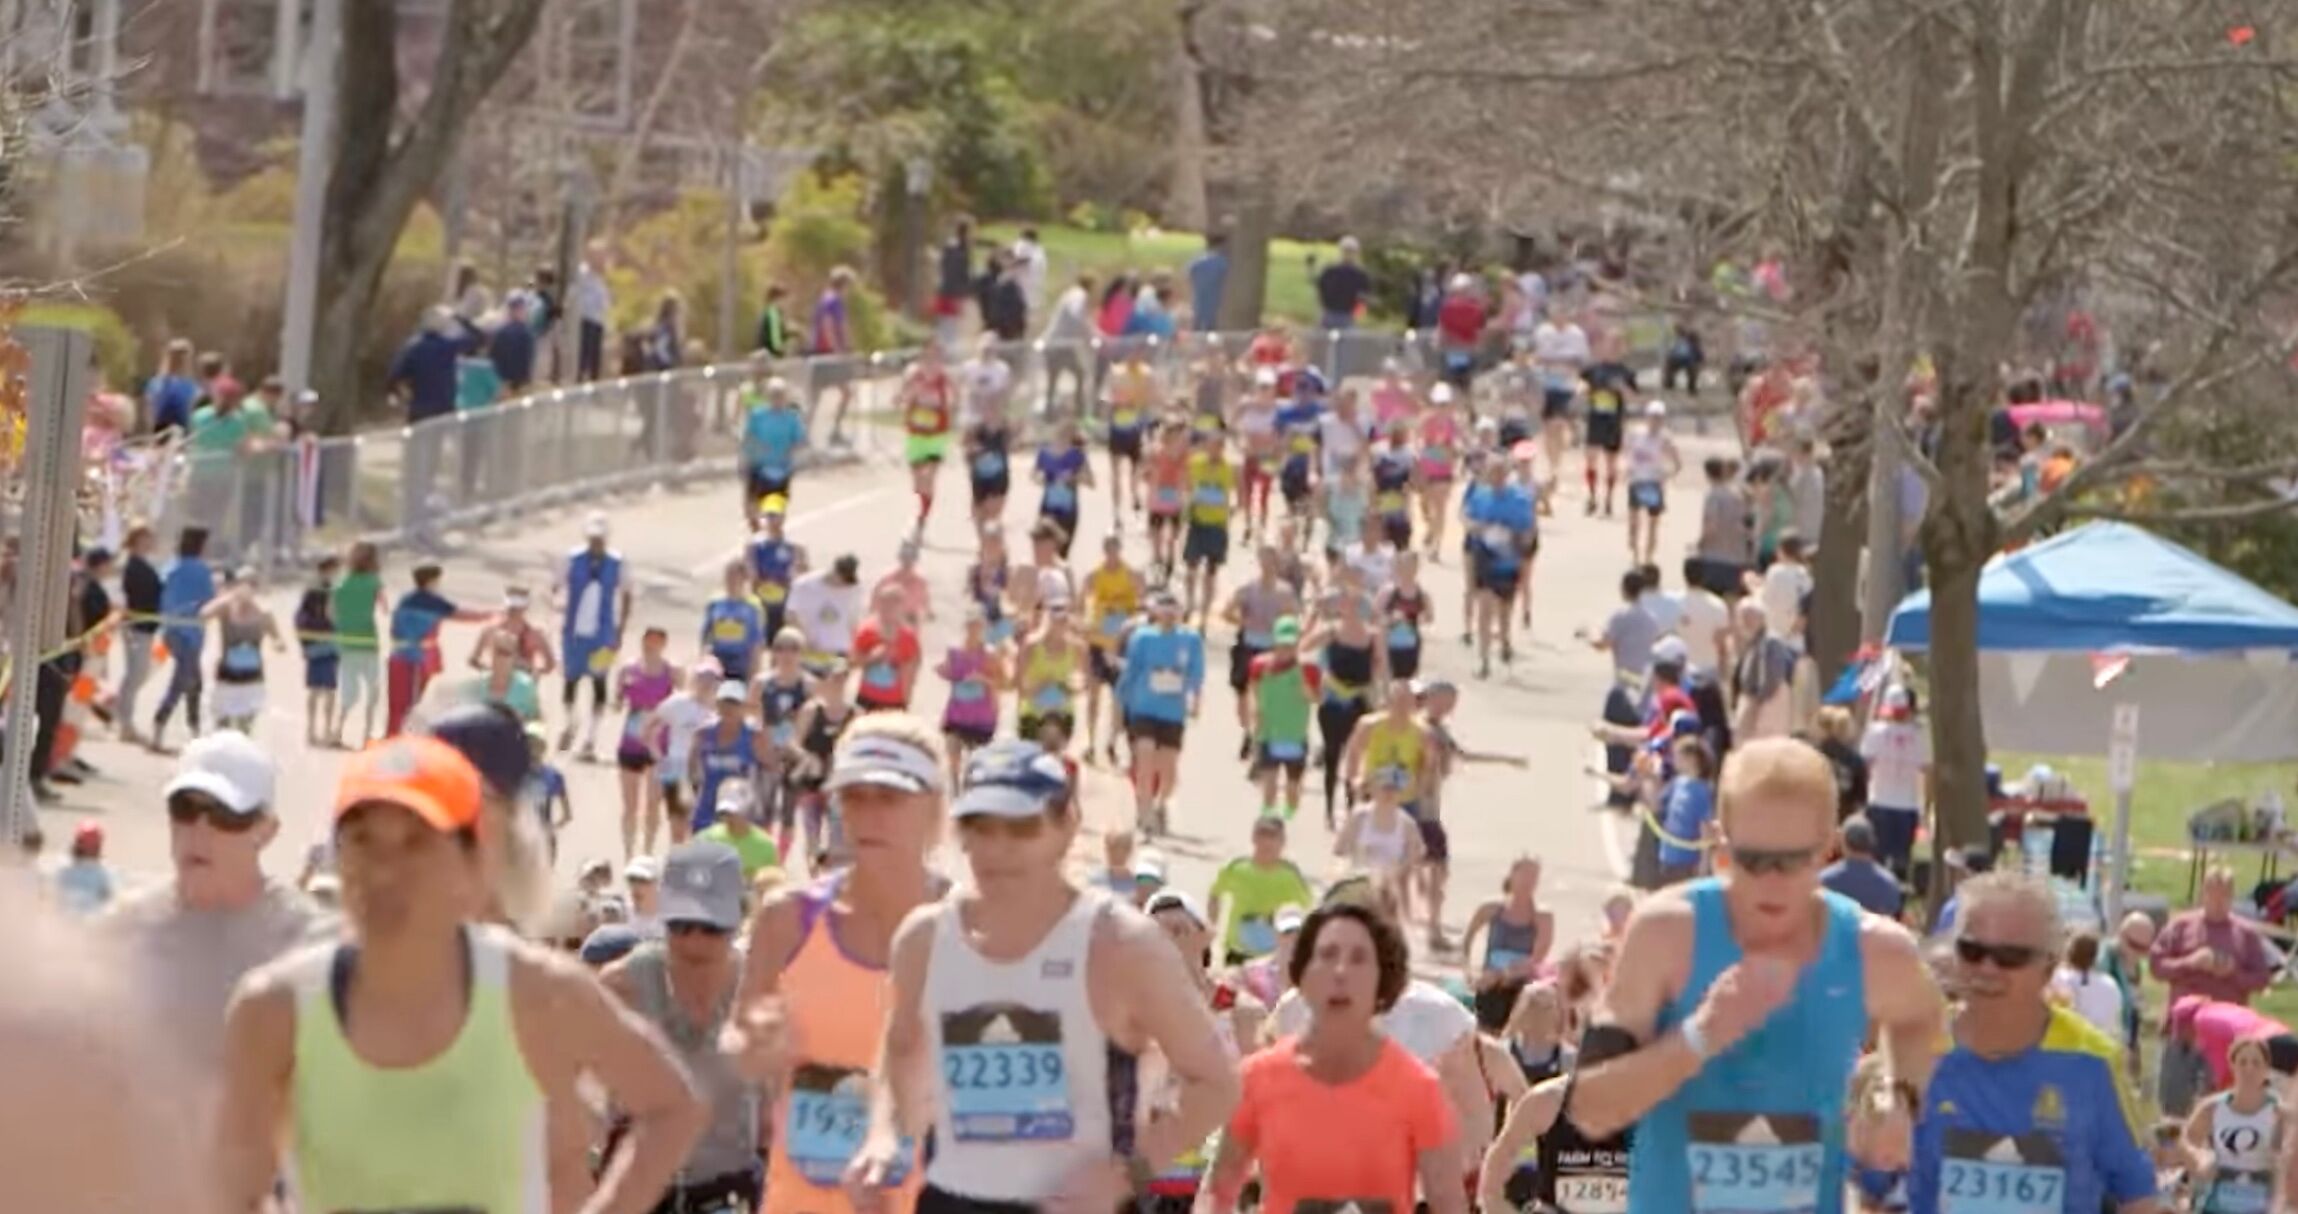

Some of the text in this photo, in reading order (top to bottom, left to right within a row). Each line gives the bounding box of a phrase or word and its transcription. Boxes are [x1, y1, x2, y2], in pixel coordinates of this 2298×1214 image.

[945, 1050, 1062, 1090] 22339
[1693, 1150, 1821, 1188] 23545
[1946, 1164, 2059, 1204] 23167
